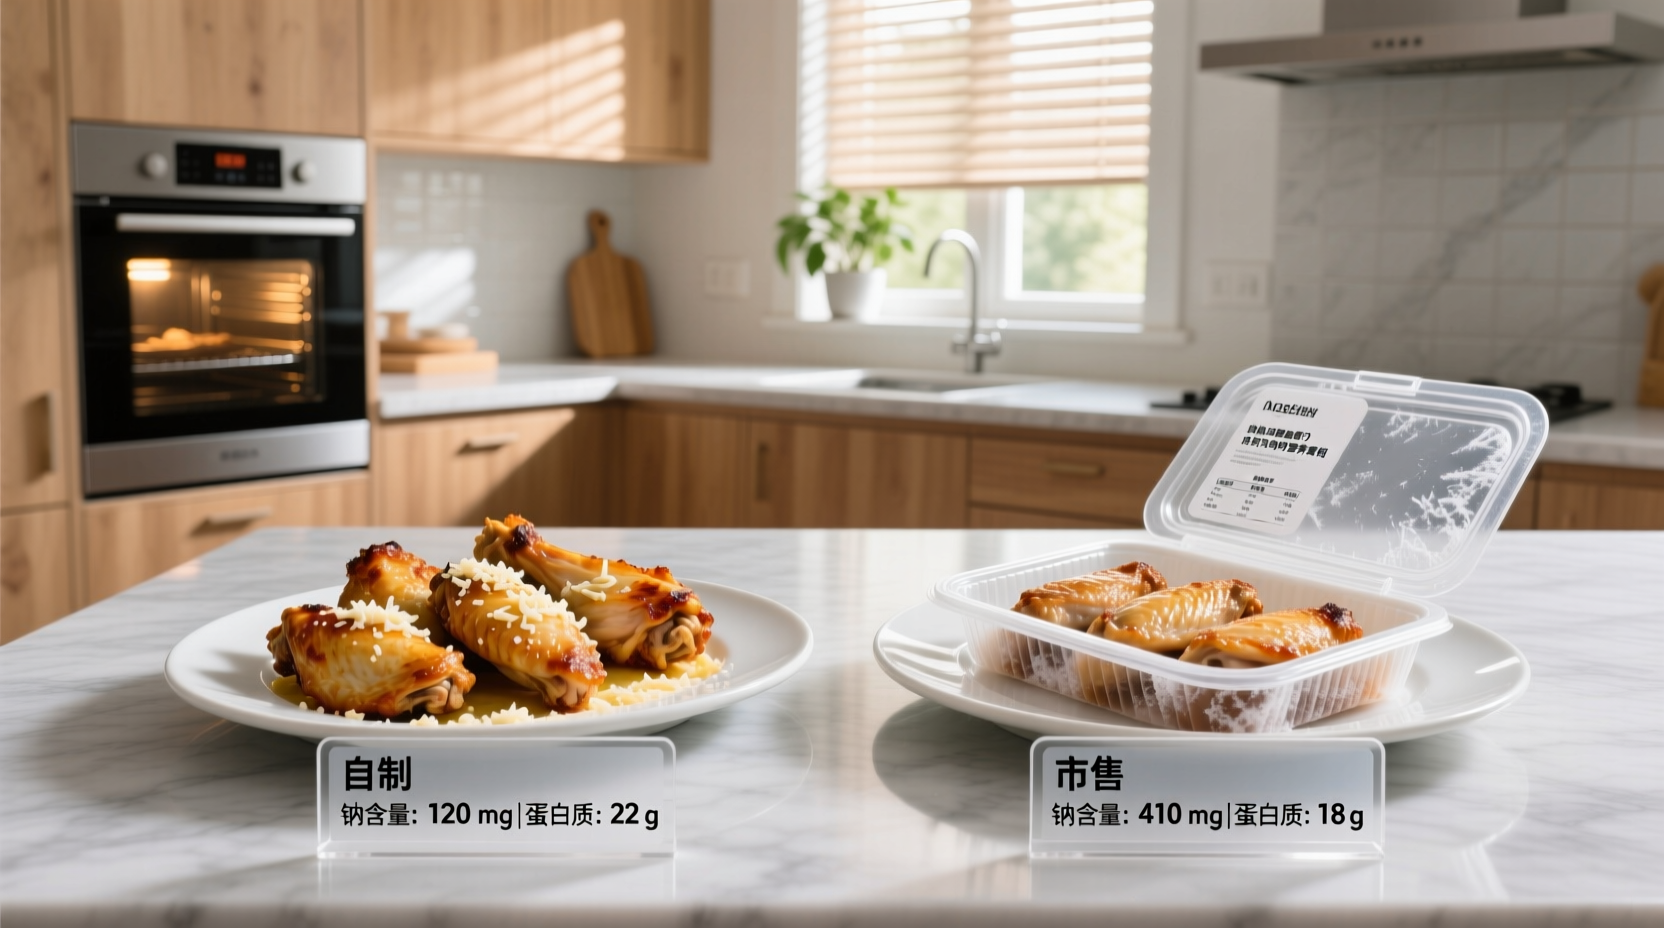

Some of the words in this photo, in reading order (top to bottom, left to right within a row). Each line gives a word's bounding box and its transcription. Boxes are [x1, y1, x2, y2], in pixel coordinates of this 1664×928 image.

[345, 755, 412, 792] 自制
[1055, 754, 1124, 792] 市售
[428, 801, 471, 825] 120
[610, 802, 639, 825] 22
[1138, 802, 1182, 825] 410
